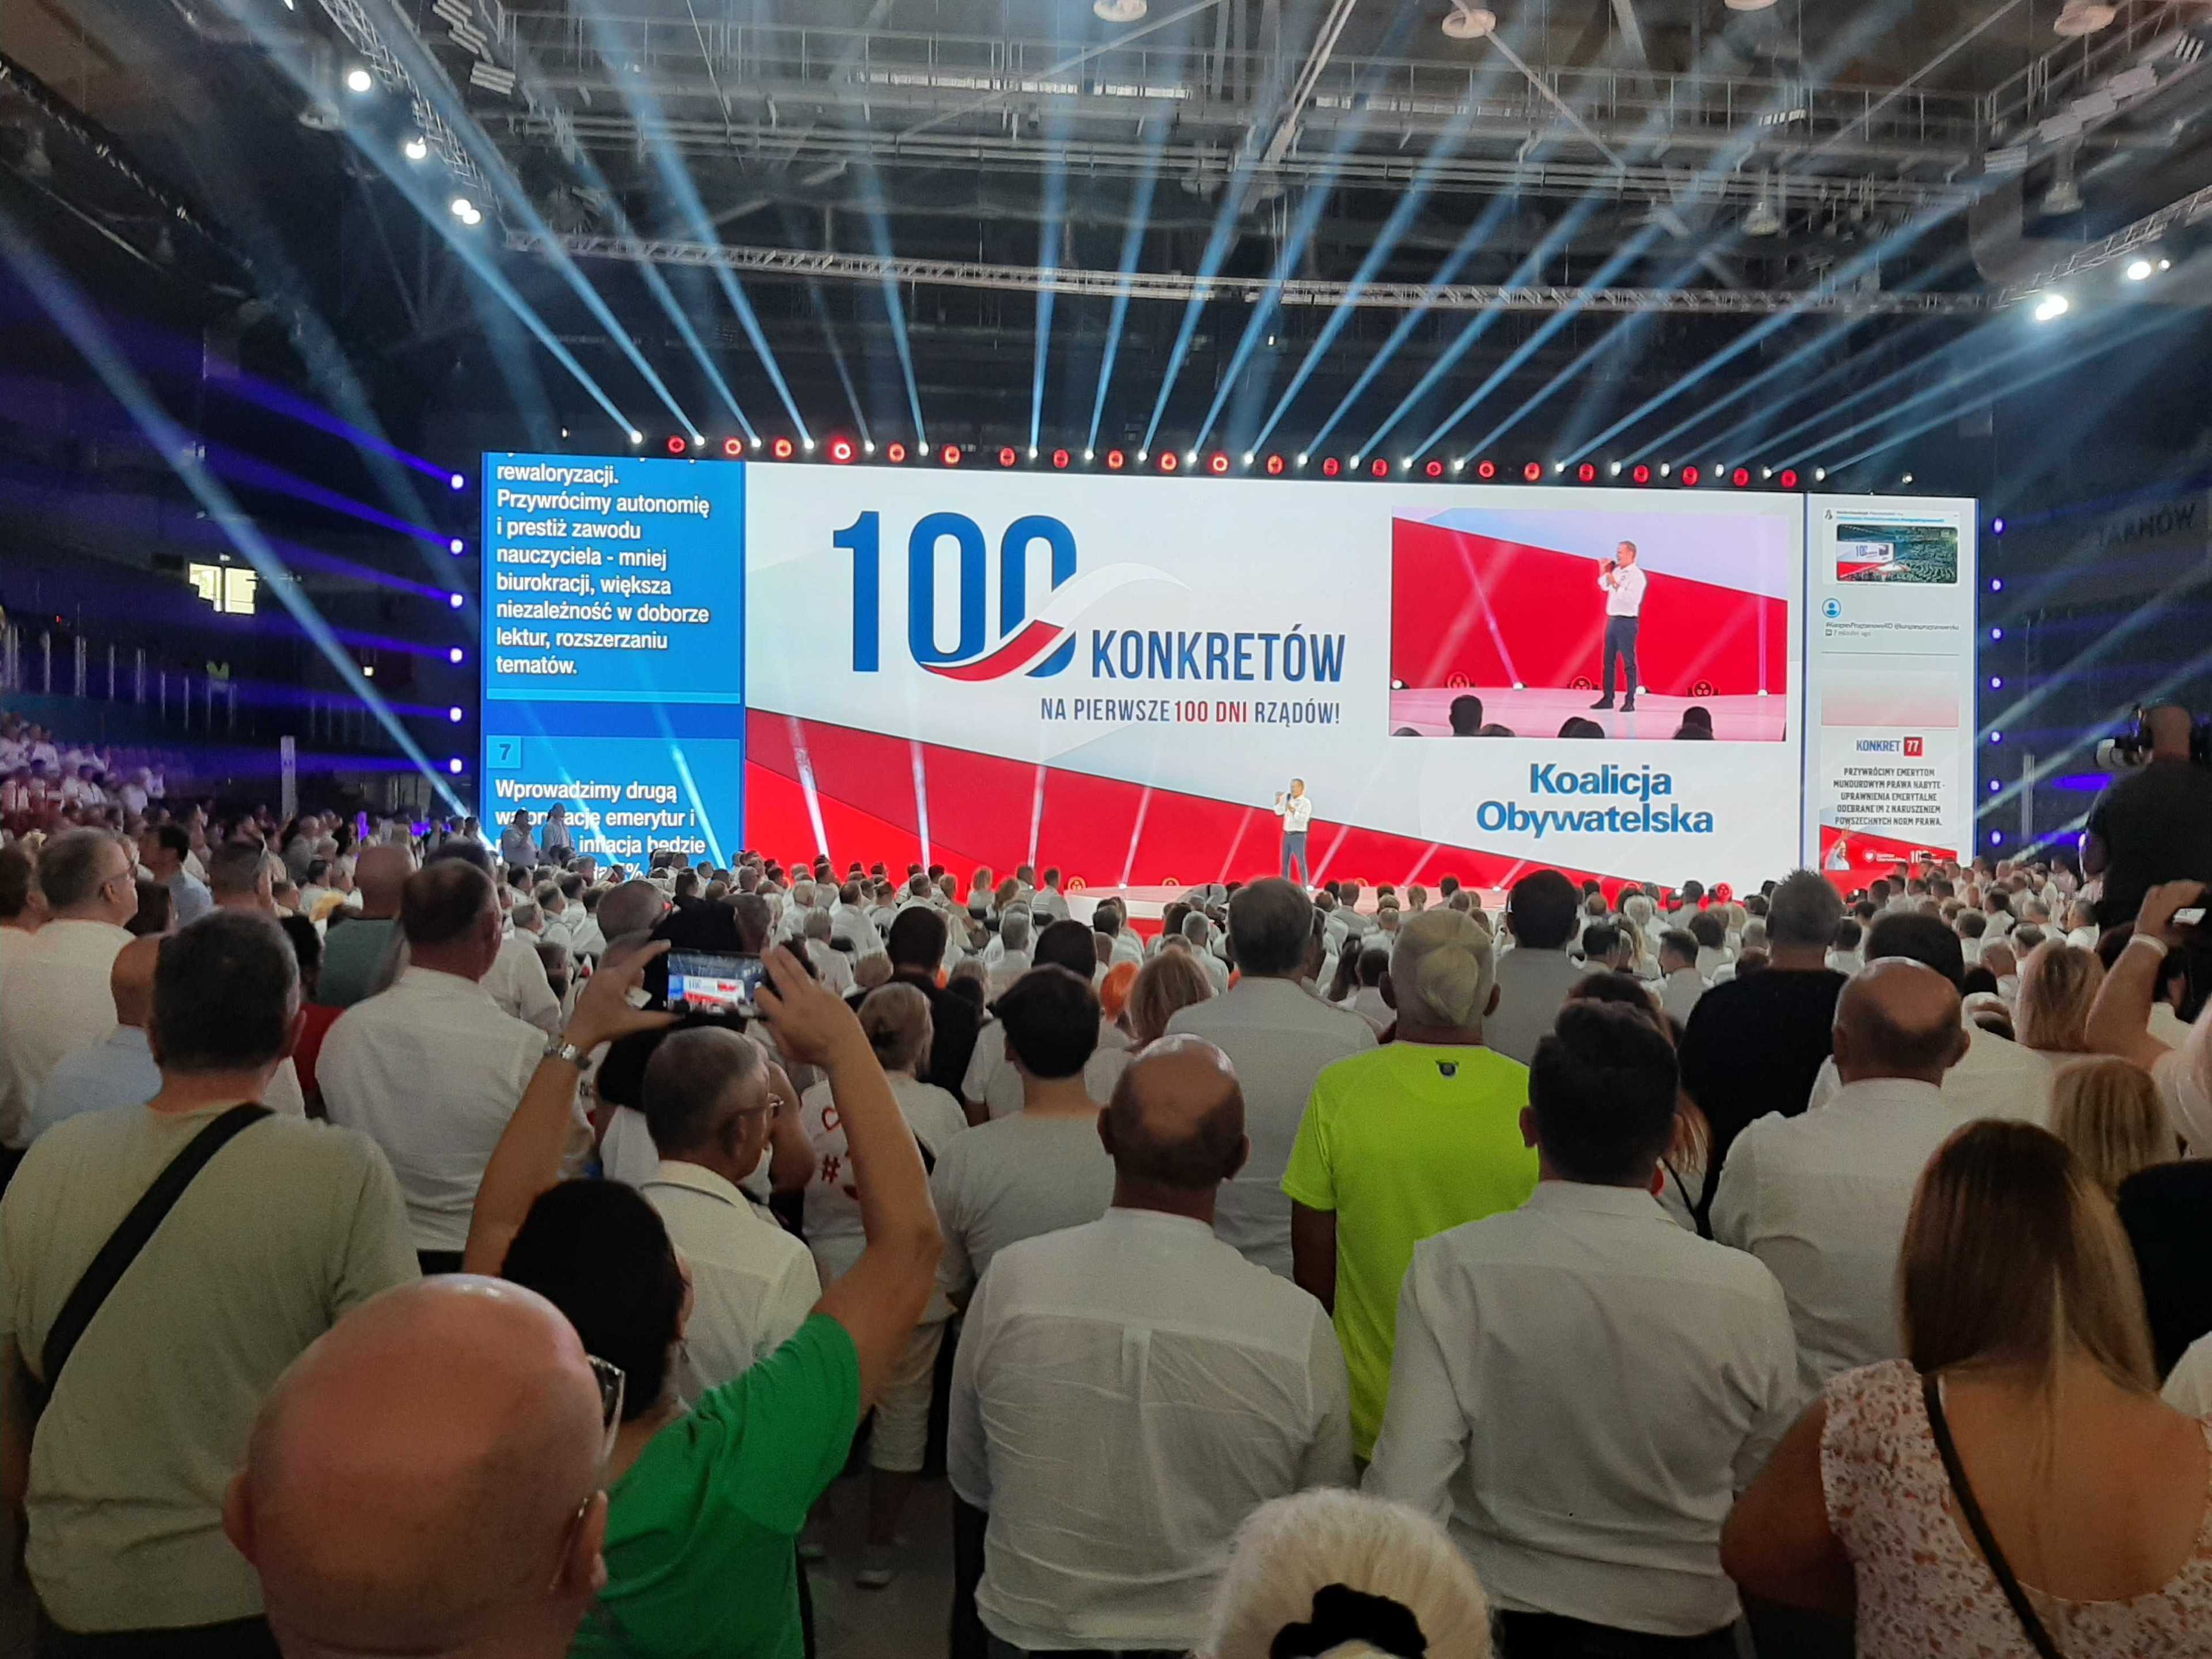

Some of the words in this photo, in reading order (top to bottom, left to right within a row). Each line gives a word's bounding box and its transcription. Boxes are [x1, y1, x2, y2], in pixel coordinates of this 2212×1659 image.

[497, 464, 619, 487] rewaloryzacji.
[497, 489, 611, 514] Przywrócimy
[616, 495, 710, 518] autonomię
[497, 517, 502, 535] i
[507, 518, 567, 539] prestiż
[572, 521, 641, 539] zawodu
[497, 547, 602, 568] nauczyciela
[619, 549, 666, 571] mniej
[497, 573, 595, 596] biurokracji,
[600, 575, 672, 597] większa
[832, 510, 1077, 680] 100
[497, 600, 612, 620] niezależność
[618, 606, 632, 620] w
[637, 603, 710, 623] doborze
[497, 627, 551, 649] lektur,
[556, 631, 668, 649] rozszerzaniu
[1092, 623, 1346, 682] KONKRETÓW
[496, 656, 578, 675] tematów.
[1041, 698, 1067, 722] NA
[1074, 699, 1169, 723] PIERWSZE
[1174, 700, 1208, 723] 100
[1215, 701, 1248, 724] DNI
[1255, 698, 1341, 728] RZĄDÓW!
[499, 744, 511, 760] 7
[1856, 740, 1900, 752] KONKRET
[1907, 740, 1919, 752] 77
[1530, 763, 1672, 801] Koalicja
[1844, 767, 1895, 777] PRZYWRÓCIMY
[1897, 768, 1935, 777] EMERYTOM
[495, 779, 620, 804] Wprowadzimy
[626, 782, 677, 804] drugą
[1834, 780, 1885, 788] MUNDUROWYM
[1887, 781, 1911, 789] PRAWA
[1914, 781, 1941, 789] NABYTE
[1841, 792, 1889, 801] UPRAWNIENIA
[1892, 793, 1937, 801] EMERYTALNE
[606, 810, 685, 830] emerytur
[690, 809, 696, 827] i
[1476, 801, 1713, 839] Obywatelska
[1837, 805, 1874, 813] ODEBRANE
[1892, 805, 1941, 813] NARUSZENIEM
[1835, 817, 1891, 825] POWSZECHNYCH
[579, 835, 642, 857] inflacja
